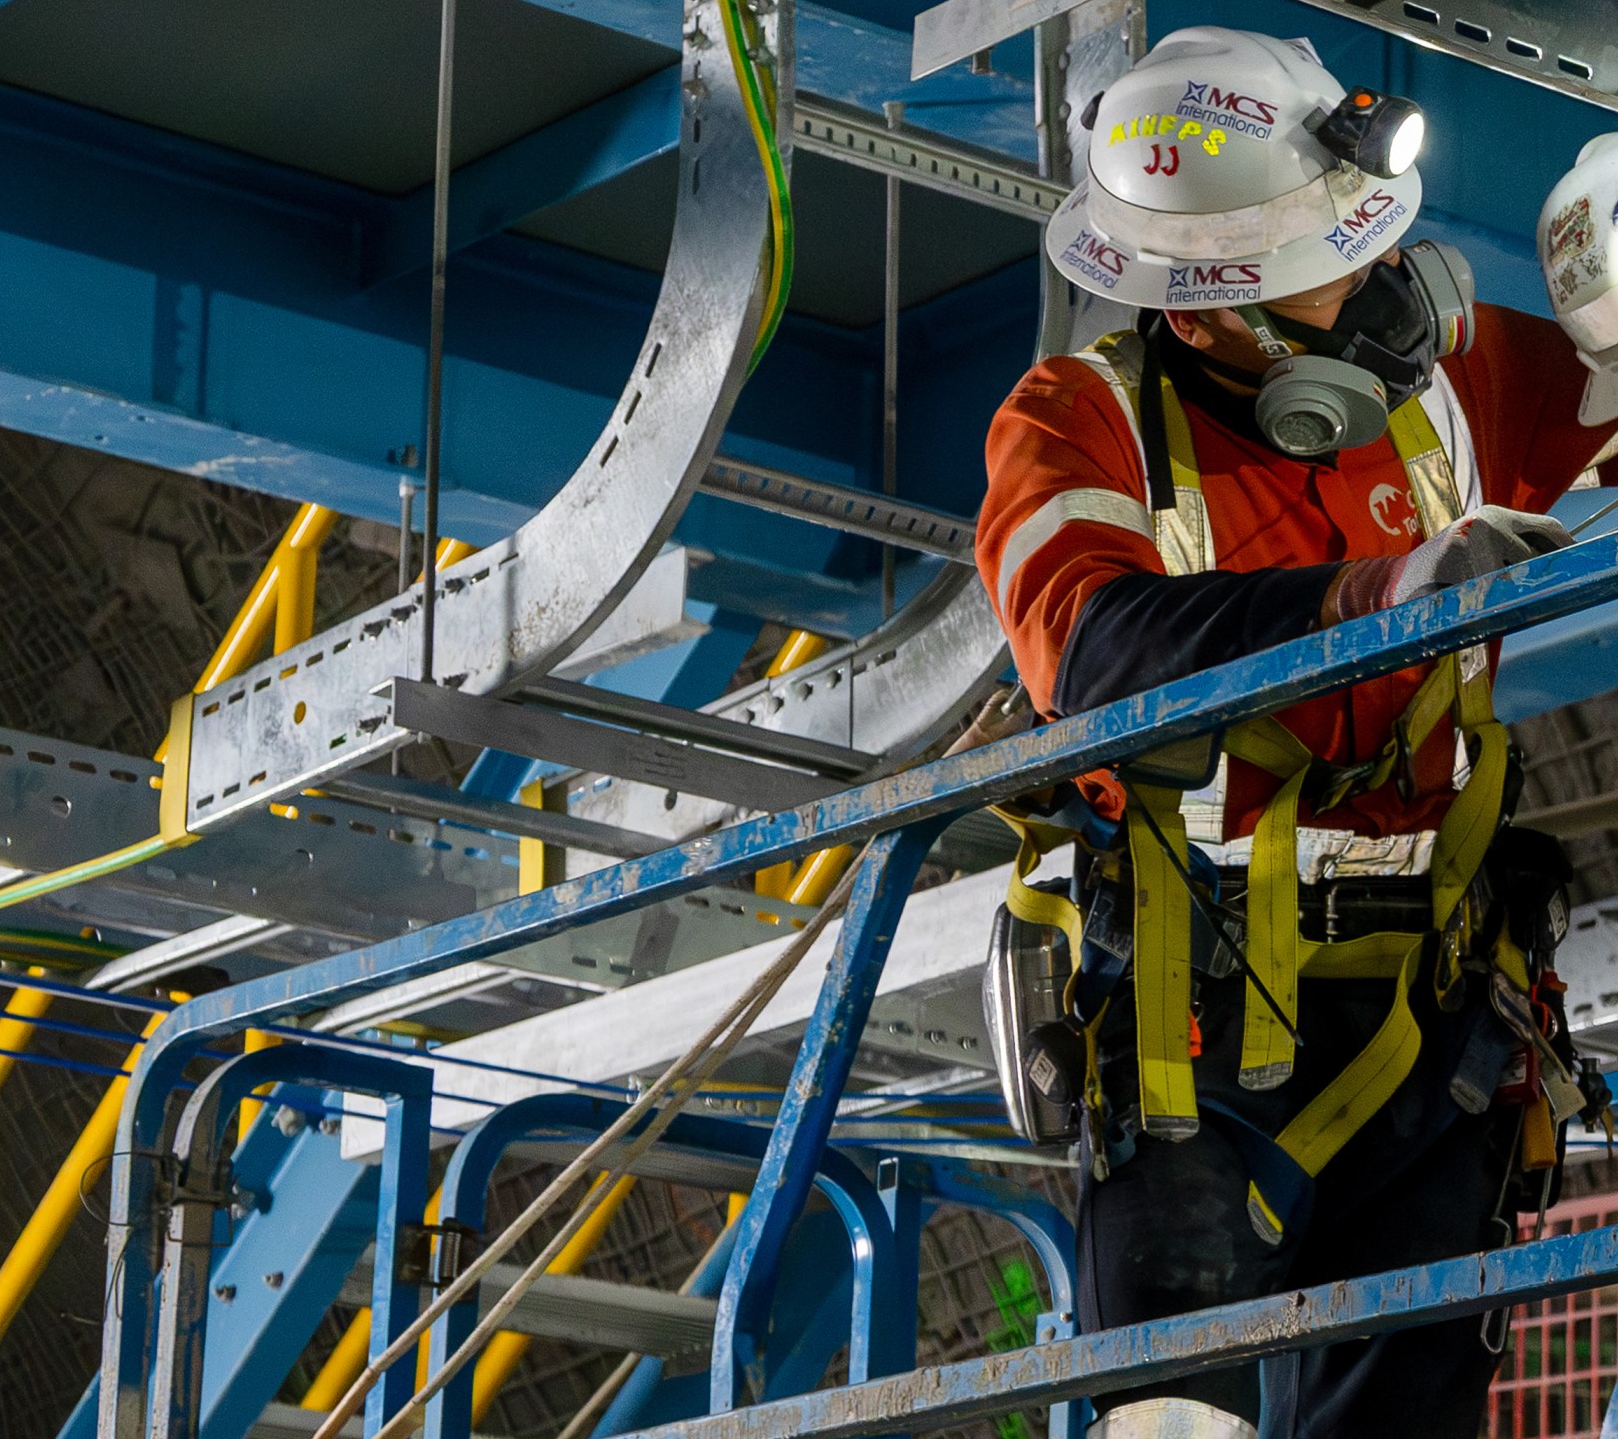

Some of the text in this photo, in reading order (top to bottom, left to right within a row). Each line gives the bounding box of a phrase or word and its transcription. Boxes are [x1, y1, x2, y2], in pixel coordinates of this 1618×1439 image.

[1207, 87, 1278, 125] MCS
[1342, 188, 1395, 234] MCS
[1082, 237, 1130, 275] MCS
[1193, 264, 1262, 286] MCS
